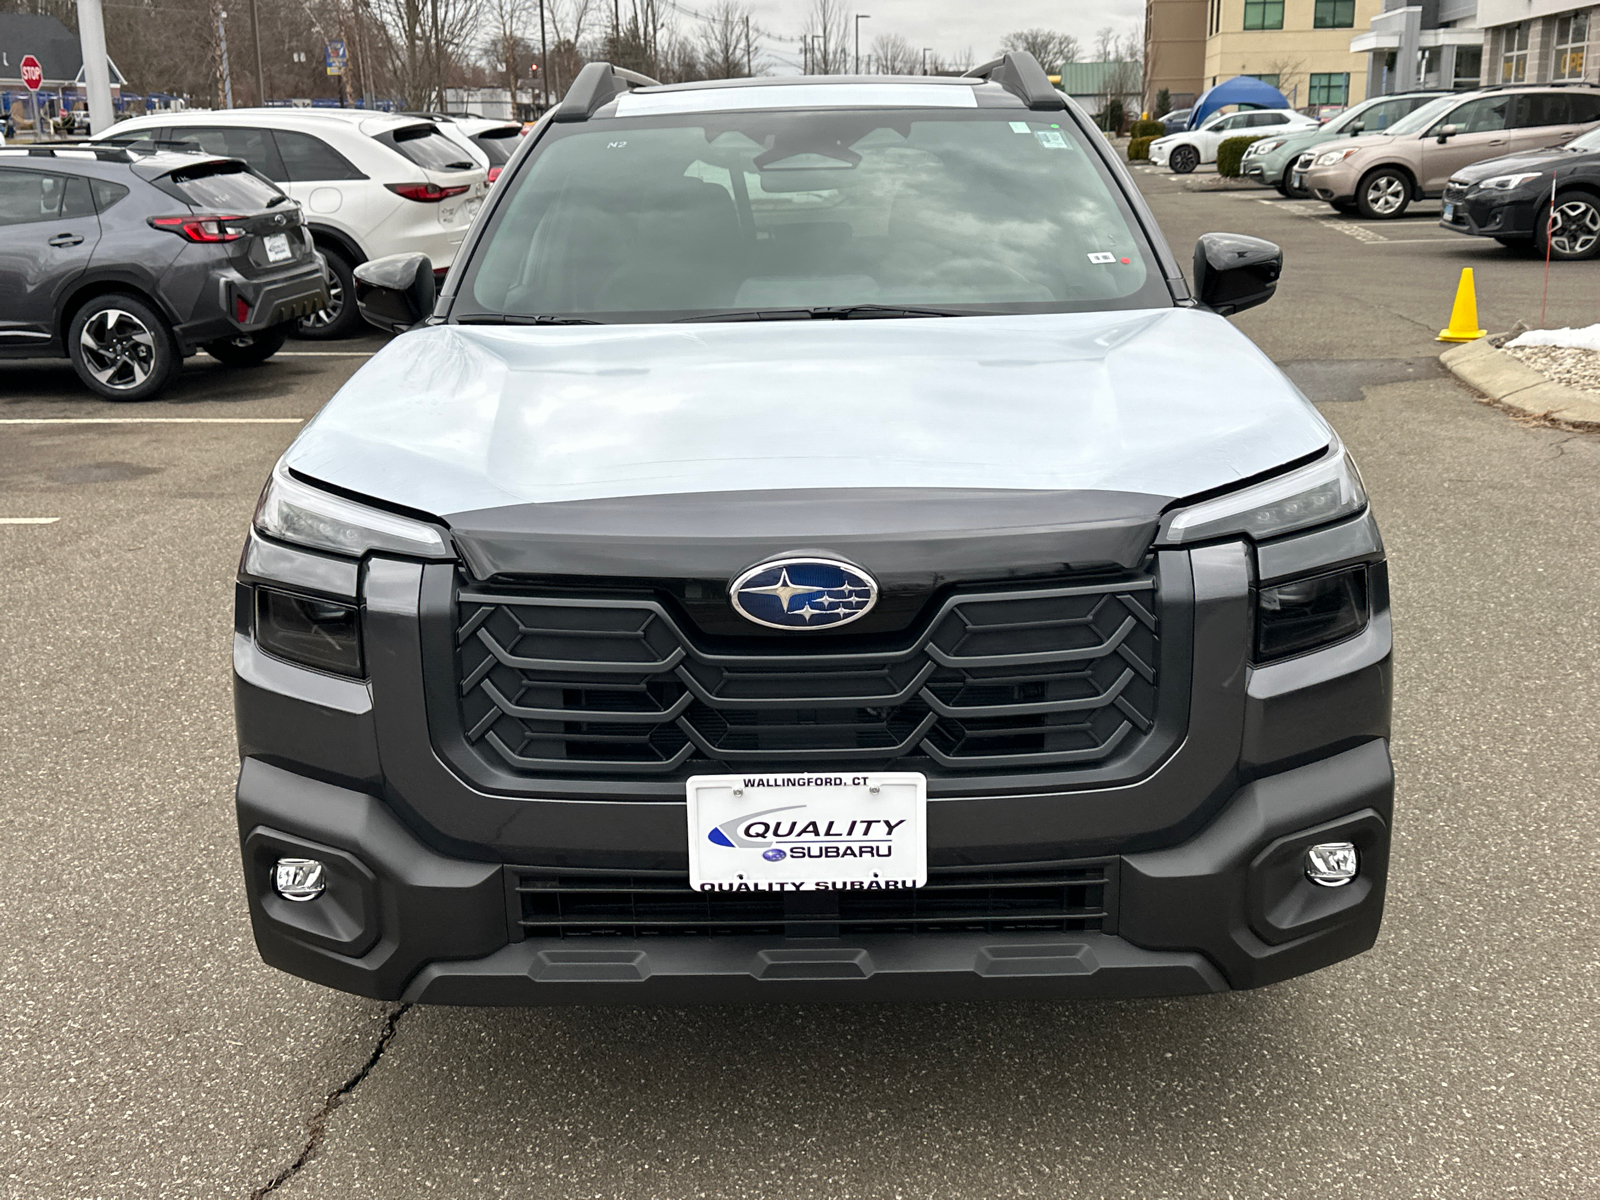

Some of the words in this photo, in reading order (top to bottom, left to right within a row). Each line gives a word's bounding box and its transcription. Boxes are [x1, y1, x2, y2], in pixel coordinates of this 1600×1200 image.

[22, 66, 40, 80] STOP
[852, 777, 869, 786] CT
[743, 819, 907, 838] QUALITY
[789, 845, 892, 859] SUBARU
[700, 882, 805, 892] QUALITY
[815, 880, 917, 891] SUBARU
